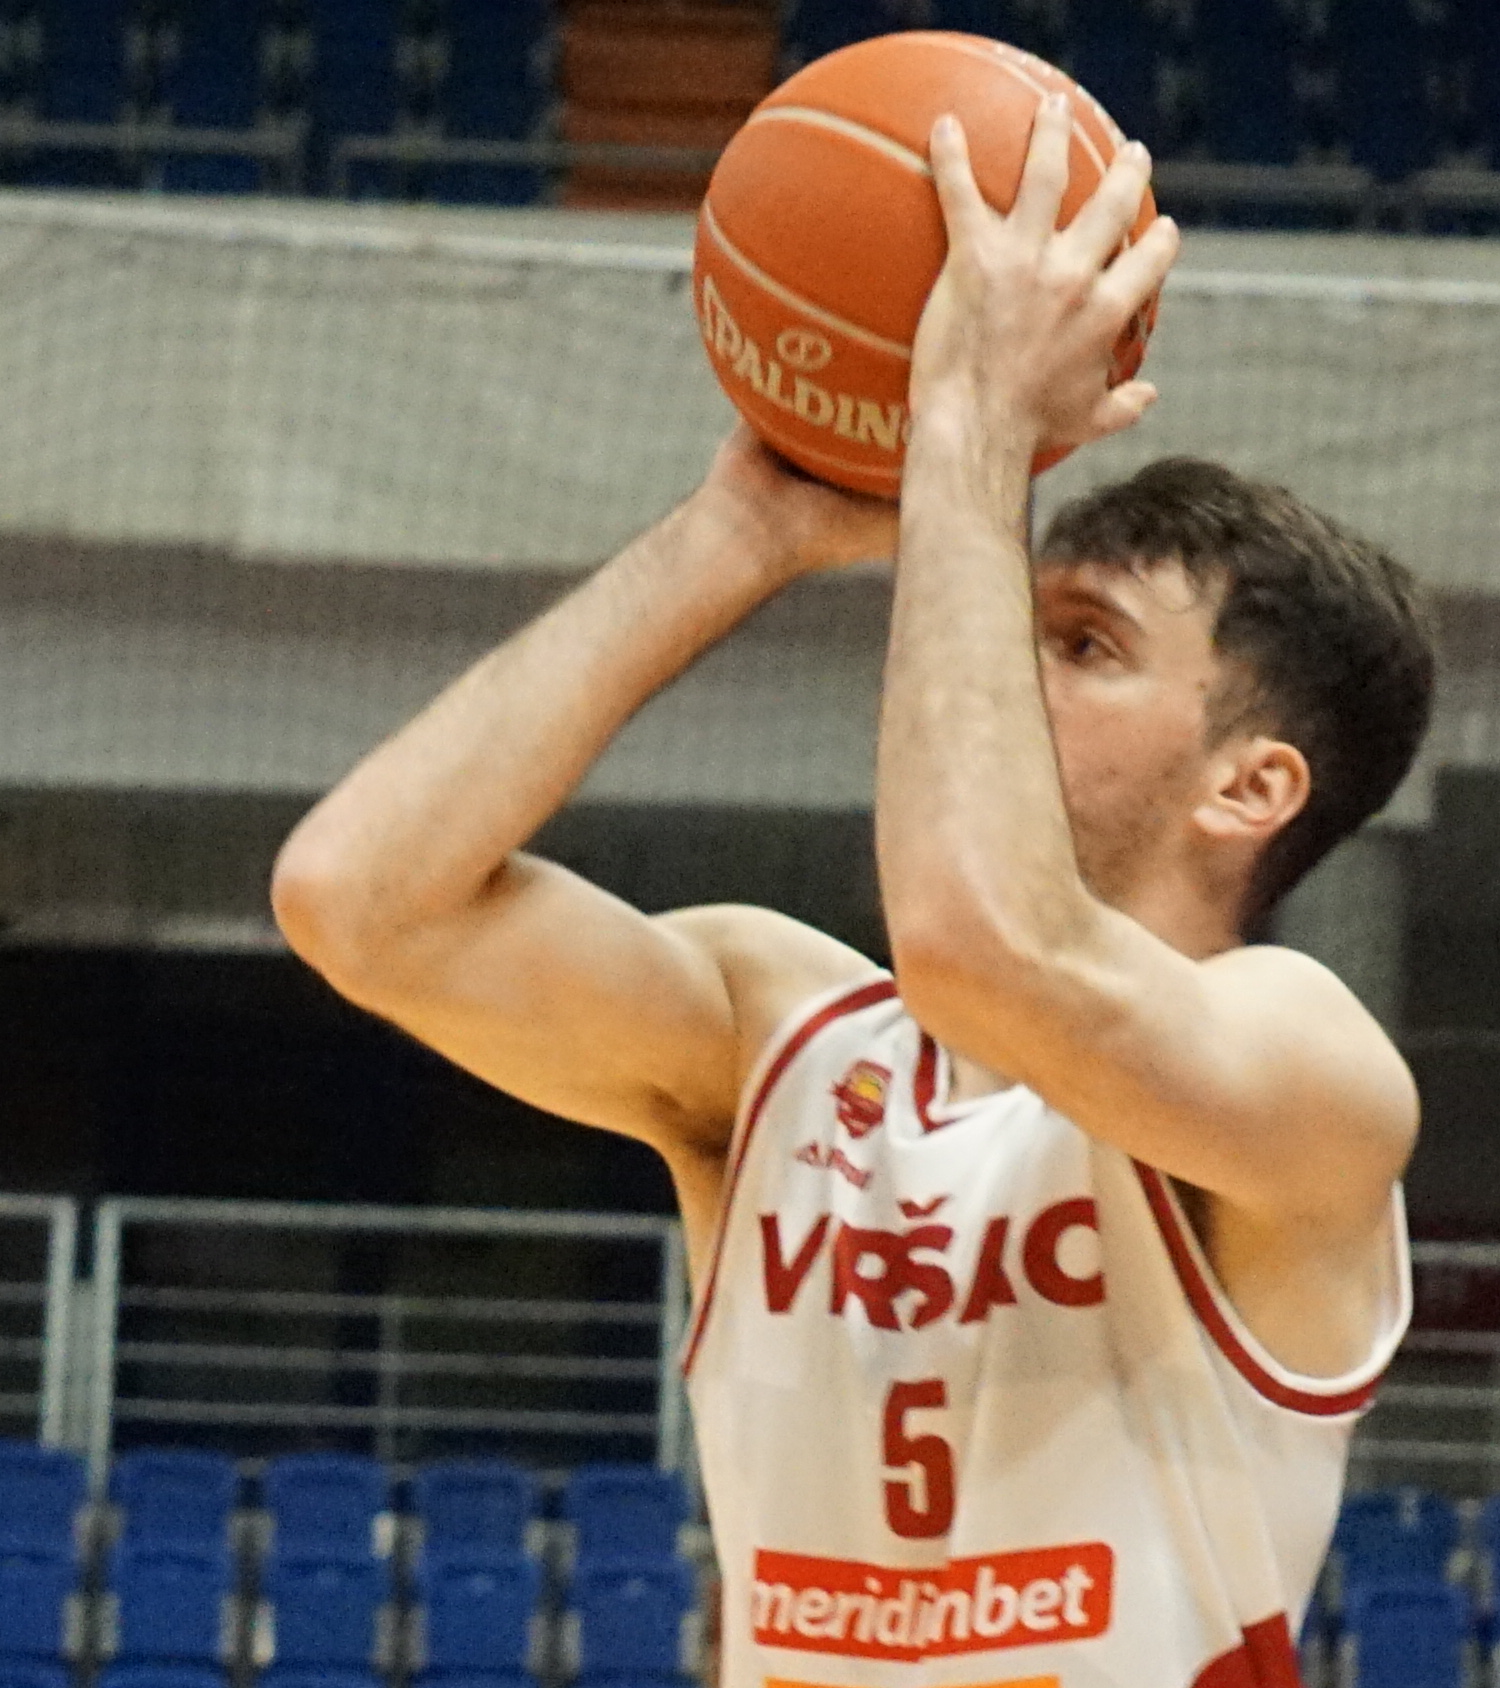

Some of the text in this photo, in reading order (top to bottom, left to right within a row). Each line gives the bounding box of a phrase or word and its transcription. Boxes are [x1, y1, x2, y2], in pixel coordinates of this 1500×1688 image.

[703, 274, 912, 453] PALDIN
[759, 1194, 1107, 1332] VRŠAC
[881, 1377, 956, 1539] 5
